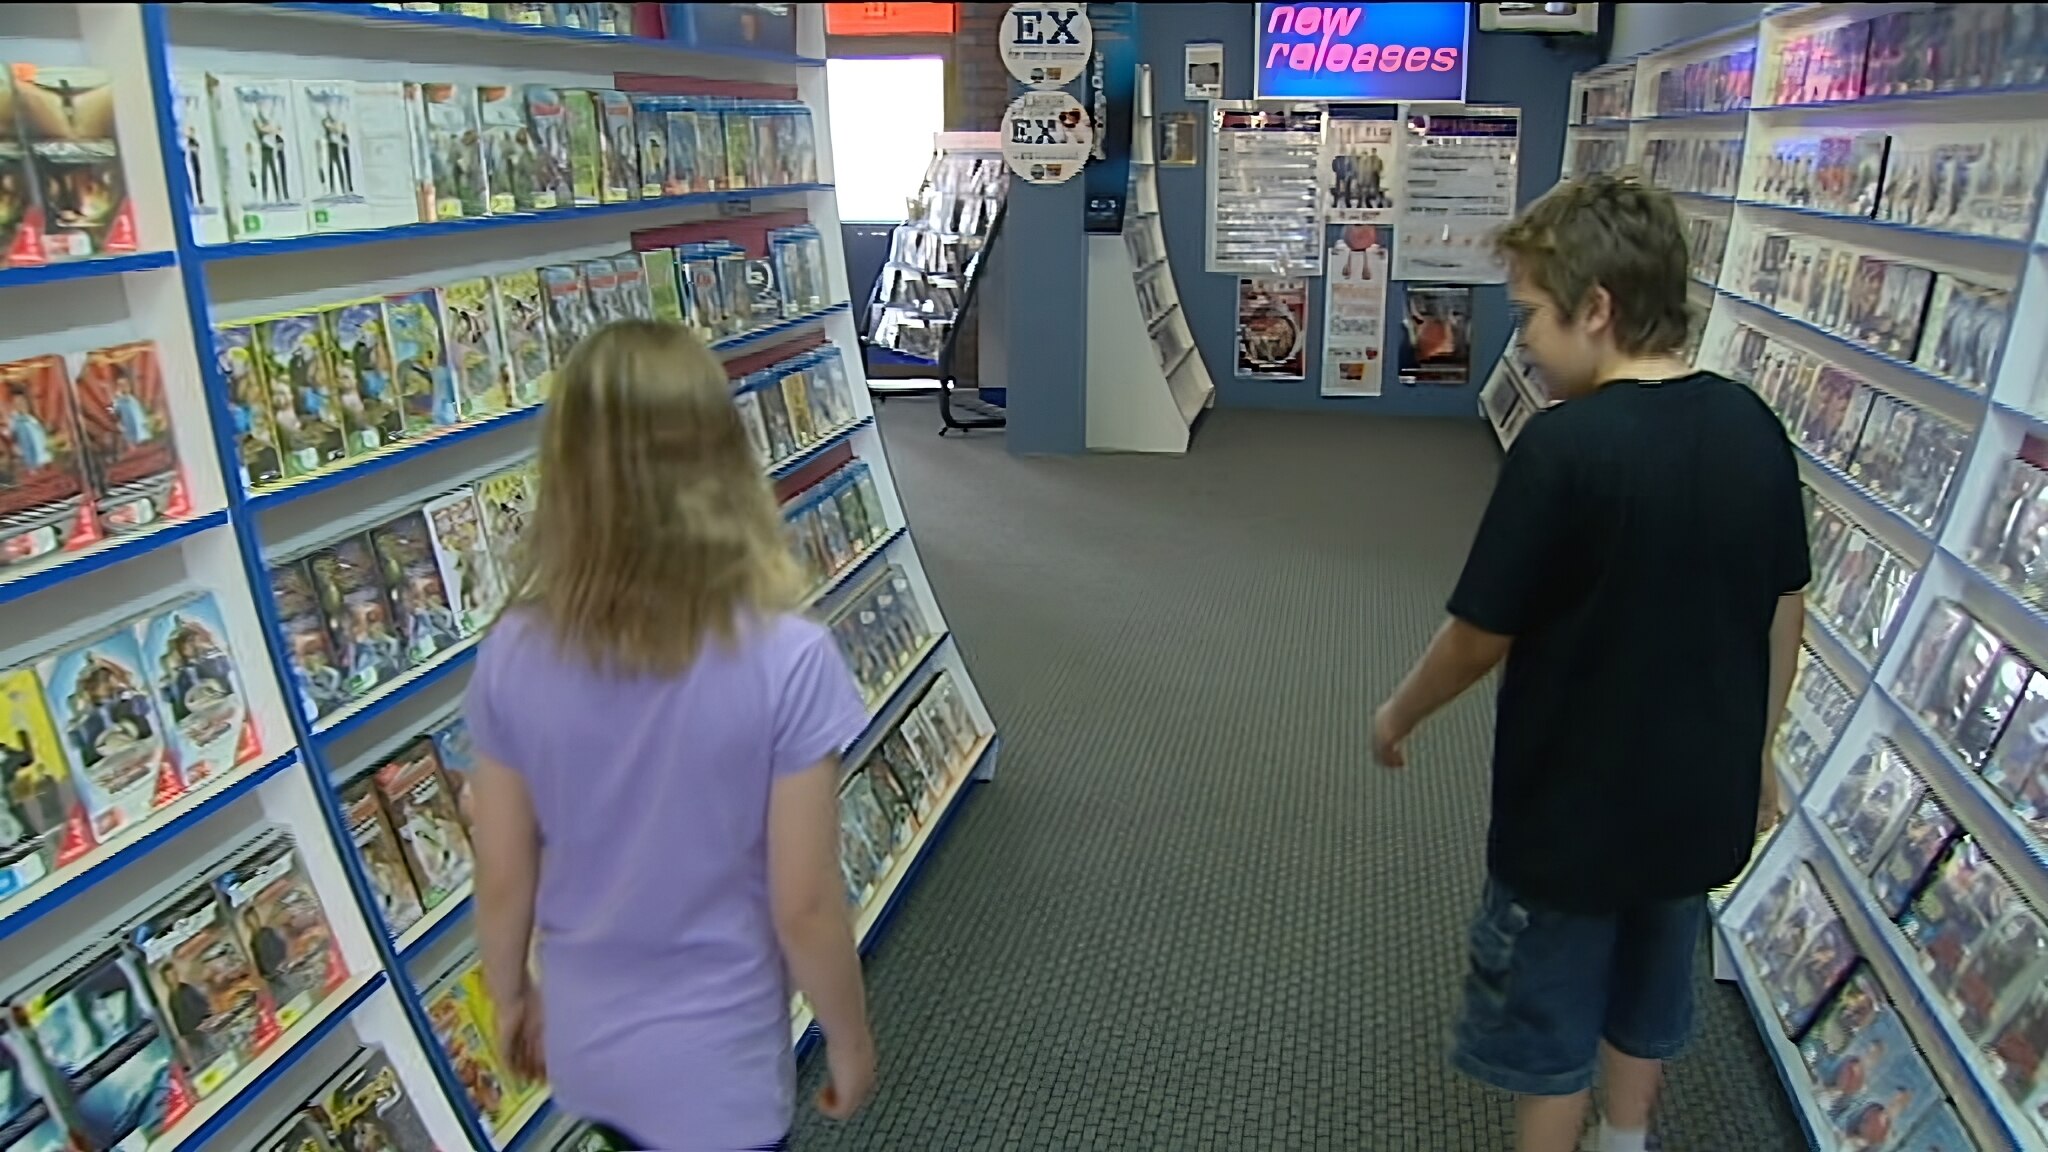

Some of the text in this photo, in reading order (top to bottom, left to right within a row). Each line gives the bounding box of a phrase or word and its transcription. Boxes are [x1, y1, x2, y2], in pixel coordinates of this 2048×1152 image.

[1012, 9, 1080, 44] EX
[1268, 6, 1362, 36] new
[1266, 33, 1458, 73] releases
